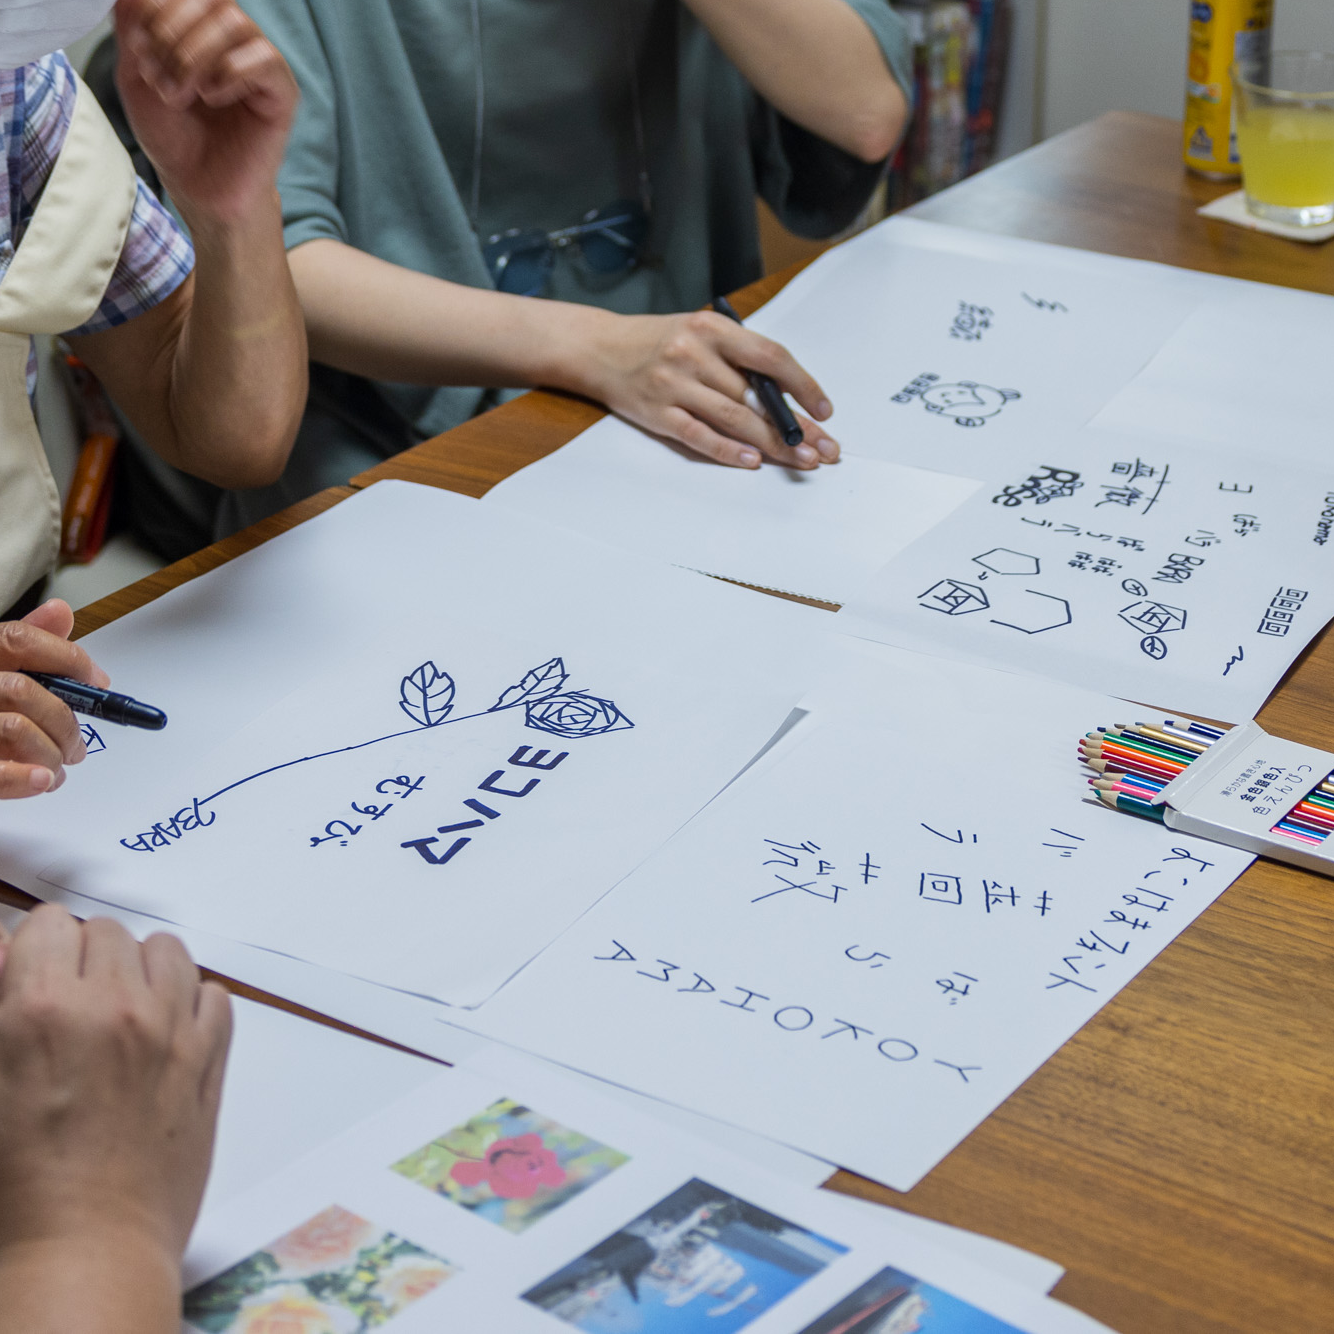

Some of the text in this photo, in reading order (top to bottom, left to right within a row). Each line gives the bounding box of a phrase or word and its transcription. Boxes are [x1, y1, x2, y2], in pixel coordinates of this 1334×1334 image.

[1252, 764, 1313, 815] 色えんぴつ
[593, 939, 984, 1084] YOKOHAMA
